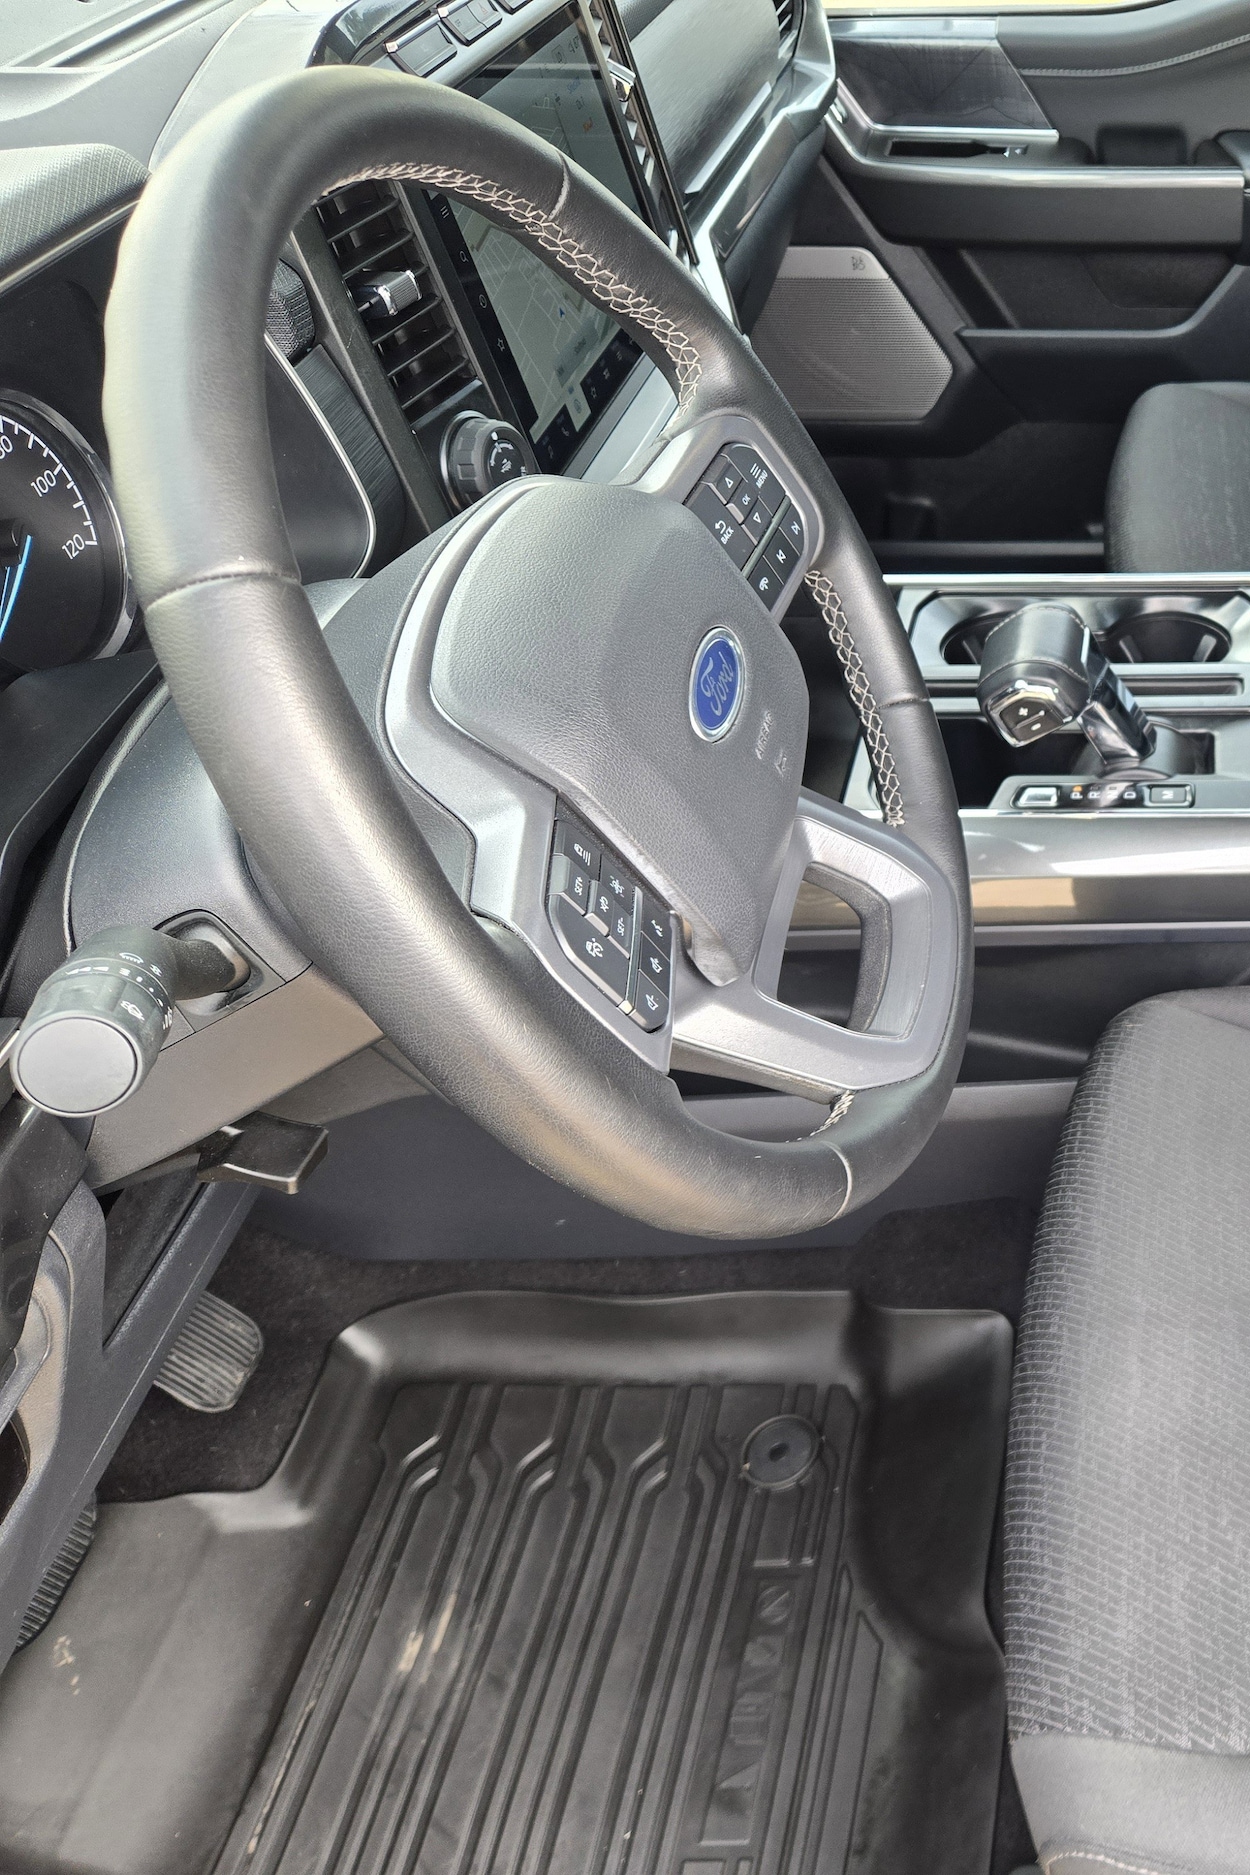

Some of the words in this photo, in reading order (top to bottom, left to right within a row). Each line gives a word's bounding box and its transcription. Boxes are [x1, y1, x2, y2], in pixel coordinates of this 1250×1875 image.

[30, 469, 56, 497] 100
[755, 469, 769, 489] MENU
[742, 493, 751, 506] OK
[721, 527, 734, 545] BACK
[62, 533, 85, 560] 120
[700, 651, 734, 717] Ford
[1070, 790, 1083, 800] P
[1087, 790, 1101, 800] R
[1123, 790, 1137, 800] D
